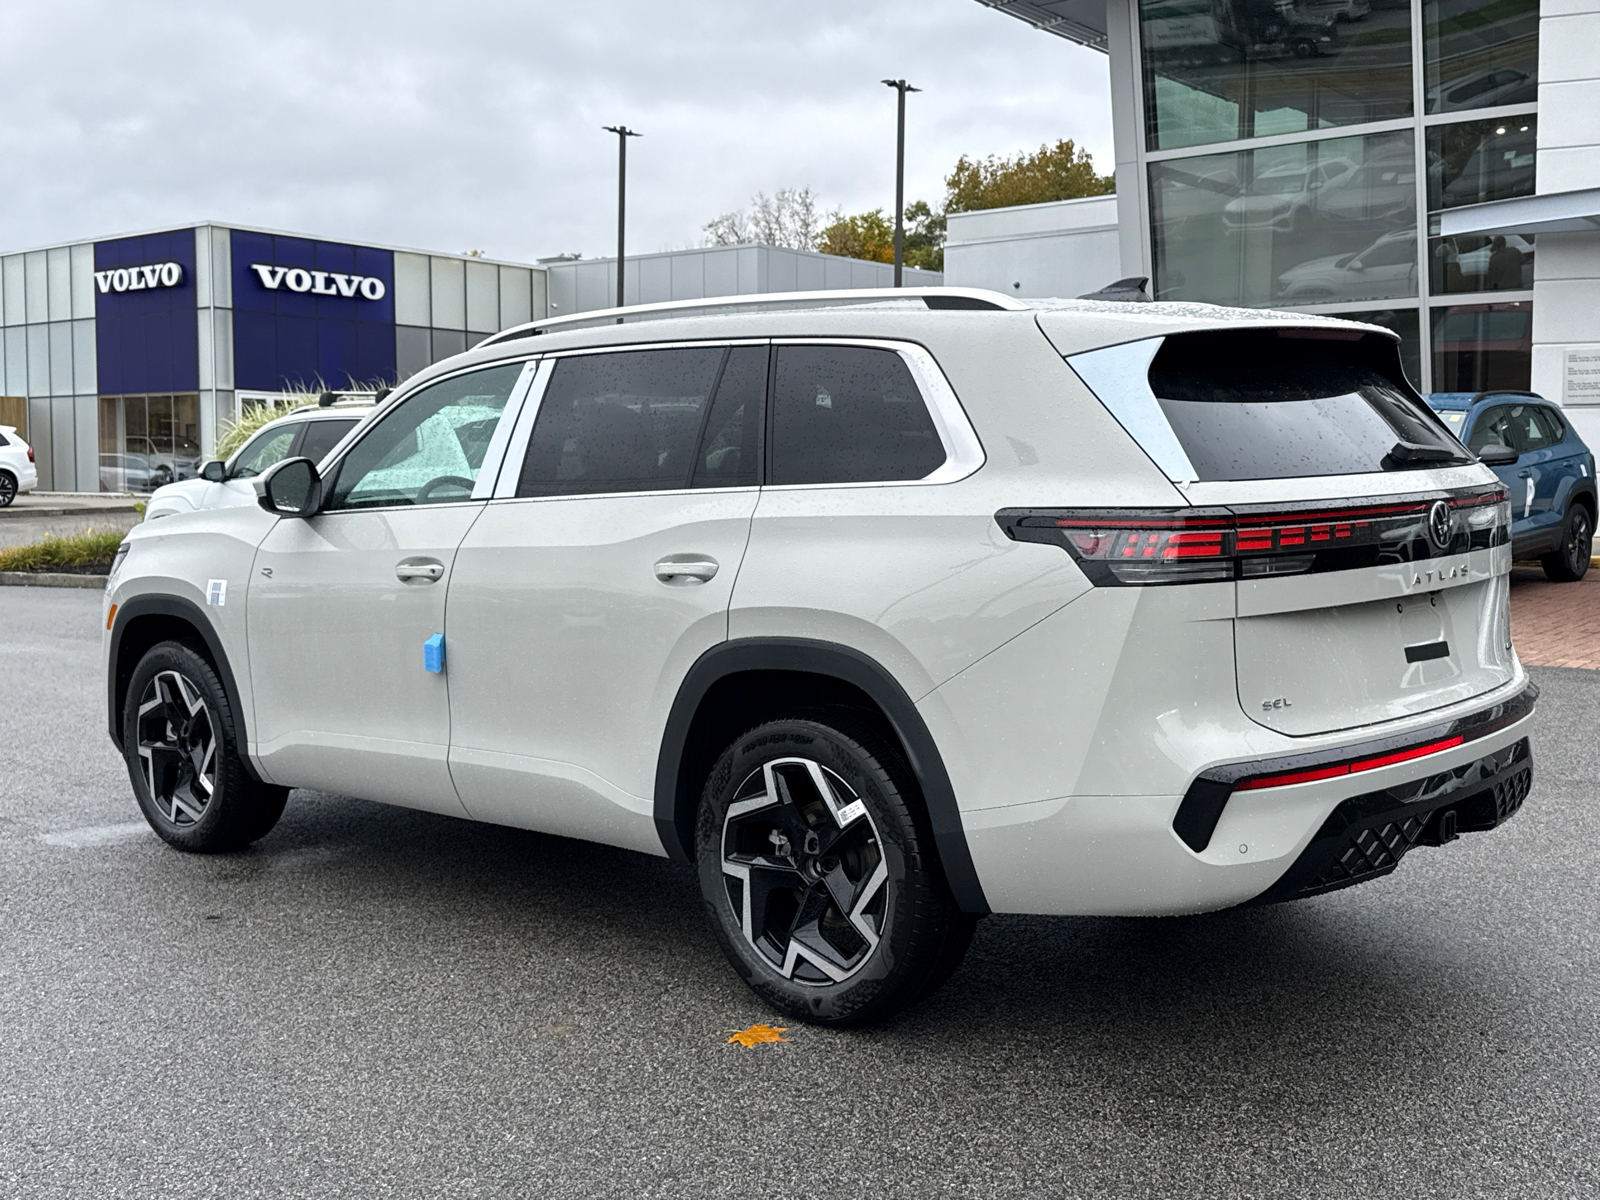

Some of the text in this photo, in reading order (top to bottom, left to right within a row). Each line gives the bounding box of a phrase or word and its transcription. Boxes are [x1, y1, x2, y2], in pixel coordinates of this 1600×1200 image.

[94, 261, 182, 293] VOLVO
[251, 264, 385, 301] VOLVO
[1412, 564, 1469, 587] ATLAS
[1262, 697, 1292, 711] SEL
